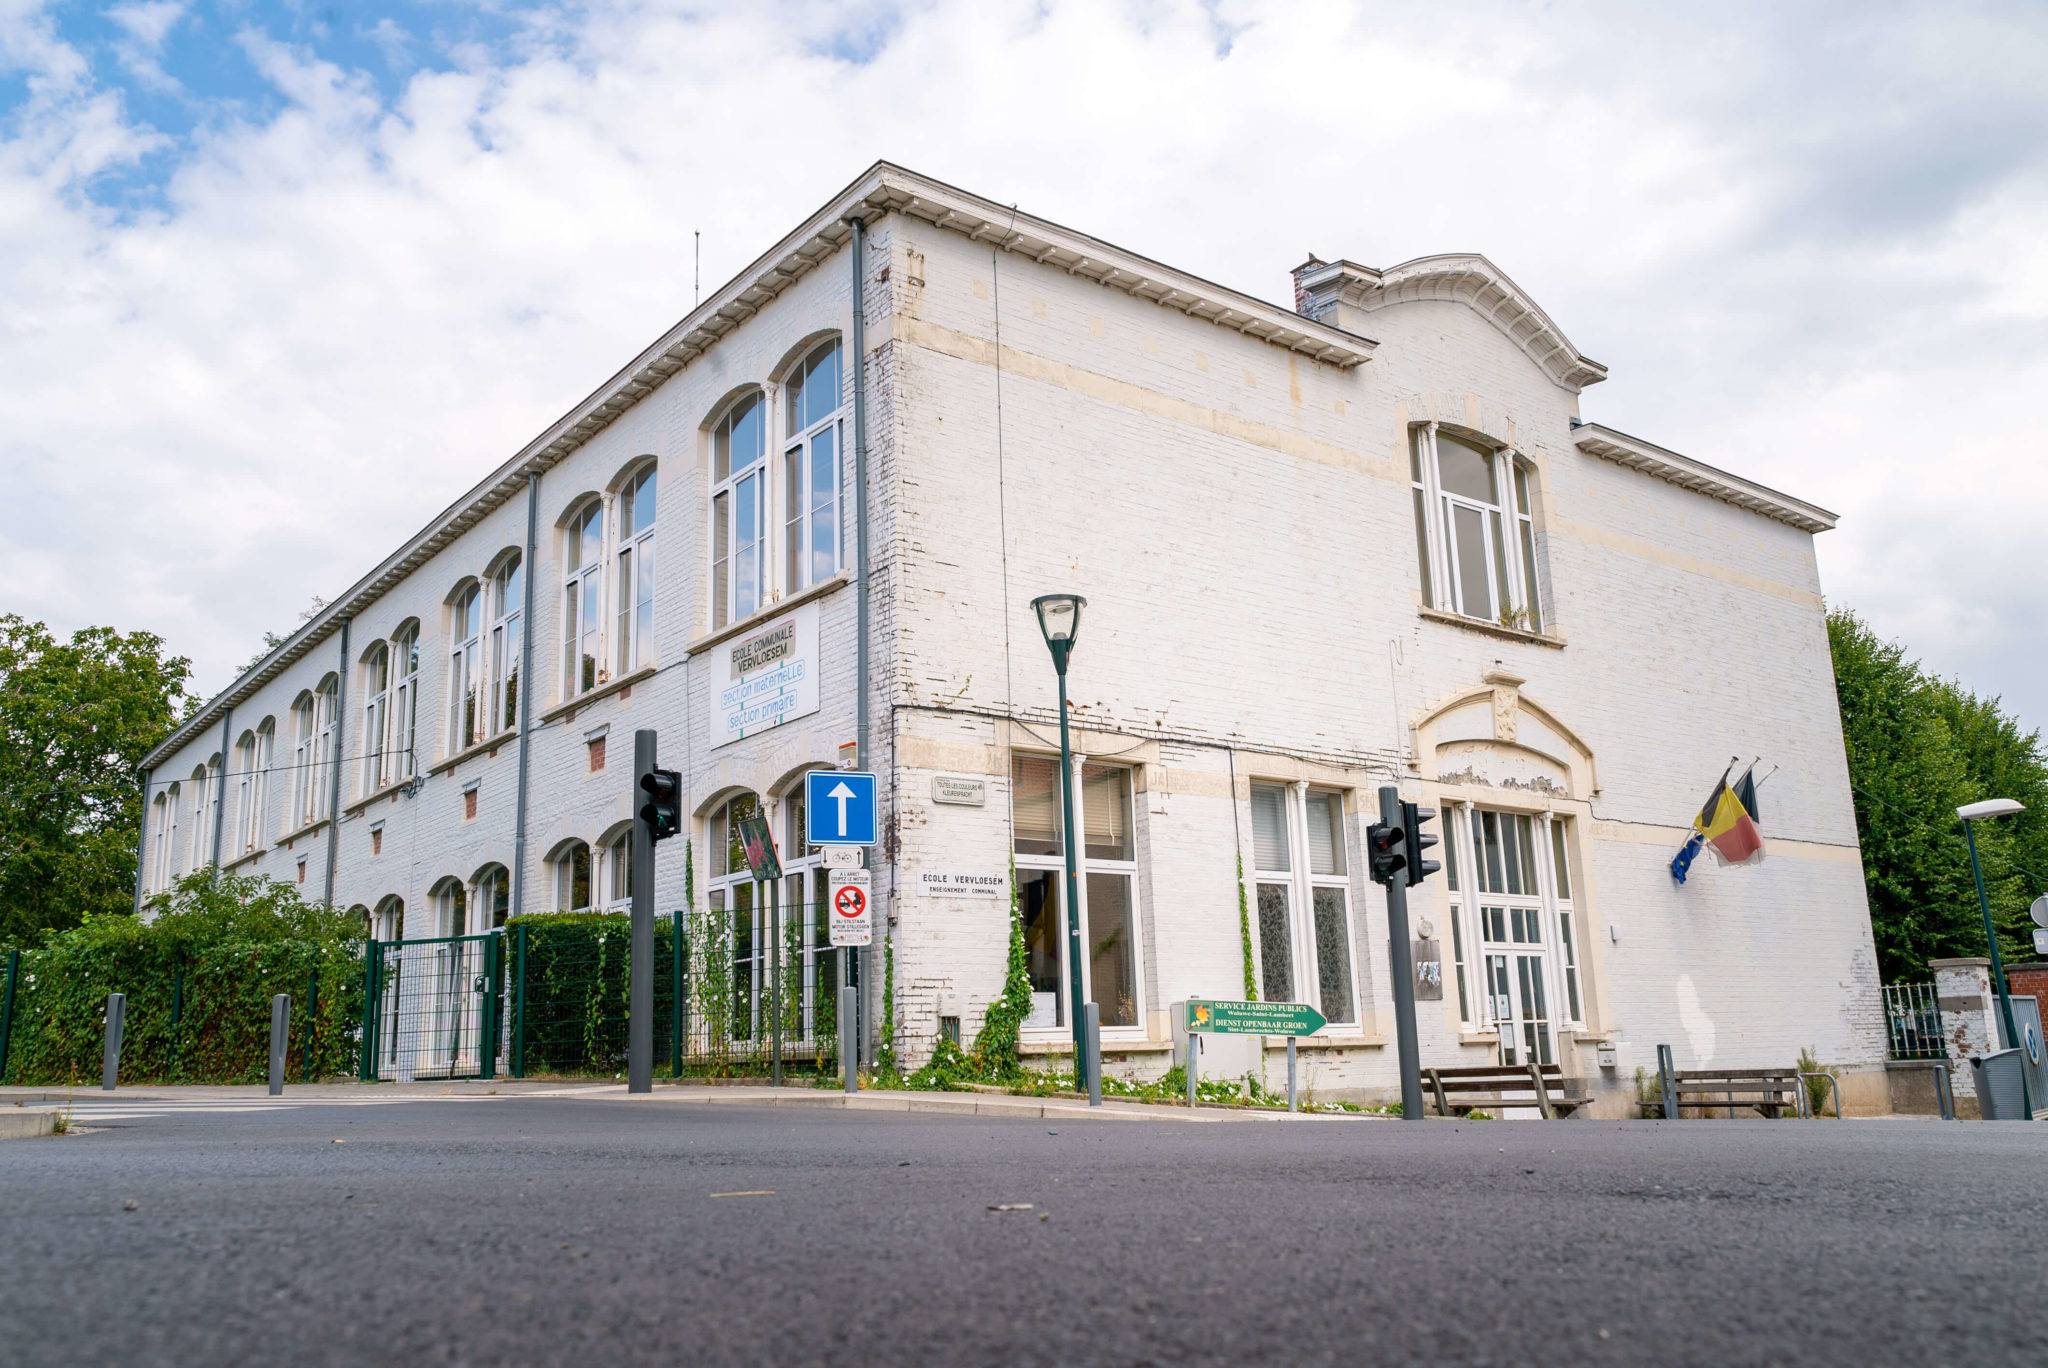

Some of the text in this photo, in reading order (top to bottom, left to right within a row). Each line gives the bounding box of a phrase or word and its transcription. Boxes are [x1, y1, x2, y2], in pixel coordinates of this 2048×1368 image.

[732, 625, 793, 663] ECOLE COMMUNALE
[738, 641, 787, 673] VERVLOESEM
[723, 664, 803, 706] section maternelle
[730, 694, 795, 728] section primaire
[923, 874, 1003, 885] ECOLE VERVLOESEM
[1215, 1002, 1307, 1013] SERVICE JARDINS PUBLICS
[1228, 1010, 1294, 1018] Woluwe-Saint-Lambert
[1215, 1019, 1307, 1029] DIENST OPENBAAR GROEN
